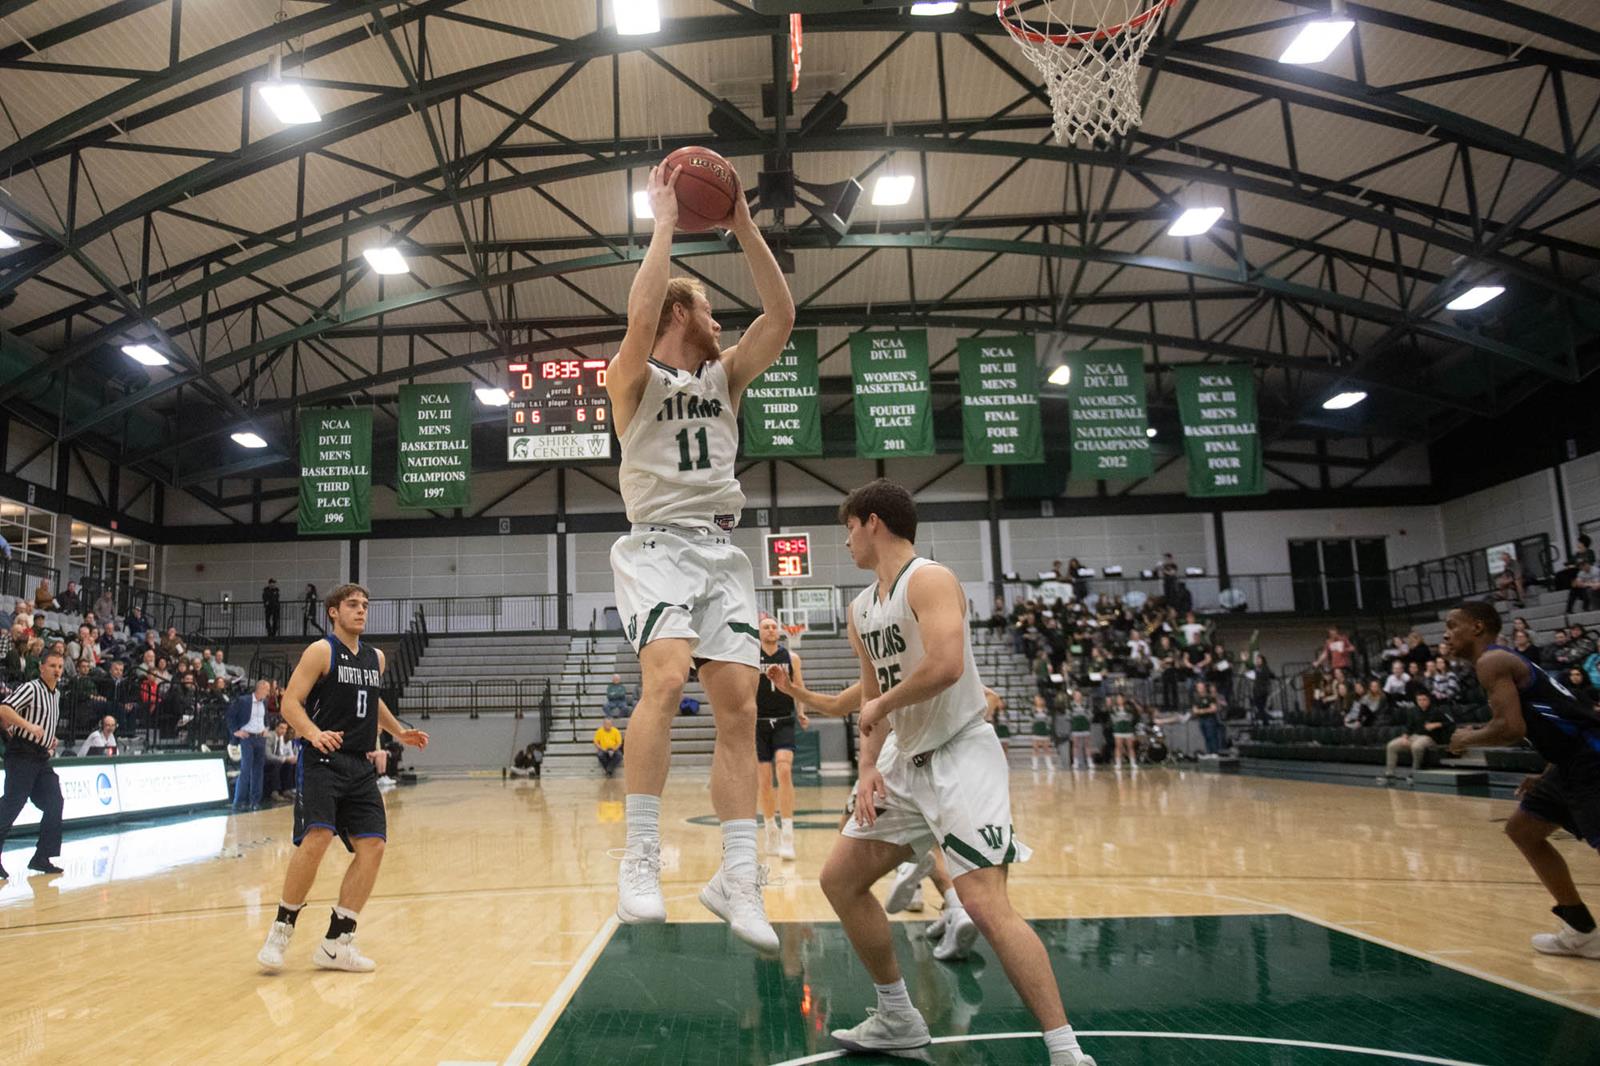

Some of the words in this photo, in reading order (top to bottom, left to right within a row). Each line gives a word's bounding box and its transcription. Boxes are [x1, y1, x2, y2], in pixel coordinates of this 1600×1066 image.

[872, 338, 904, 349] NCAA
[870, 350, 892, 360] DIV.
[894, 349, 907, 359] III
[981, 348, 1014, 358] NCAA
[785, 356, 798, 365] III
[980, 363, 1001, 373] DIV.
[1003, 362, 1016, 373] III
[1085, 363, 1124, 375] NCAA
[522, 373, 533, 390] 0
[542, 361, 580, 379] 19:35
[596, 369, 607, 387] 0
[764, 372, 797, 382] MEN'S
[863, 371, 917, 383] WOMEN'S
[1199, 376, 1232, 386] NCAA
[982, 379, 1016, 389] MEN'S
[1084, 376, 1112, 388] DIV.
[1114, 375, 1129, 387] III
[747, 386, 816, 398] BASKETBALL
[856, 382, 927, 395] BASKETBALL
[420, 395, 450, 404] NCAA
[965, 394, 1037, 406] BASKETBALL
[1078, 394, 1137, 406] WOMEN'S
[1222, 391, 1236, 402] III
[548, 399, 568, 407] player
[763, 403, 798, 413] THIRD
[417, 410, 437, 420] DIV.
[440, 409, 452, 419] III
[515, 410, 525, 424] 0
[531, 410, 540, 424] 6
[576, 408, 586, 422] 6
[596, 407, 605, 421] 0
[870, 404, 916, 416] FOURTH
[1072, 408, 1146, 420] BASKETBALL
[1200, 408, 1237, 419] MEN'S
[875, 416, 912, 427] PLACE
[985, 411, 1019, 421] FINAL
[321, 420, 351, 430] NCAA
[764, 419, 800, 429] PLACE
[1184, 423, 1257, 436] BASKETBALL
[418, 425, 451, 435] MEN'S
[987, 427, 1018, 438] FOUR
[1077, 426, 1144, 438] NATIONAL
[319, 435, 339, 445] DIV.
[340, 435, 352, 444] III
[539, 435, 579, 447] SHIRK
[772, 435, 794, 445] 2006
[884, 440, 905, 450] 2011
[1074, 438, 1149, 451] CHAMPIONS
[401, 440, 468, 452] BASKETBALL
[675, 426, 712, 472] 11
[992, 443, 1015, 454] 2012
[1204, 441, 1240, 452] FINAL
[319, 451, 351, 461] MEN'S
[532, 446, 585, 458] CENTER
[407, 456, 461, 467] NATIONAL
[1098, 456, 1127, 468] 2012
[1208, 457, 1240, 469] FOUR
[301, 465, 369, 477] BASKETBALL
[402, 471, 466, 483] CHAMPIONS
[316, 482, 350, 492] THIRD
[424, 488, 444, 498] 1997
[317, 498, 351, 508] PLACE
[324, 513, 344, 523] 1996
[773, 539, 807, 554] 19:35
[778, 556, 801, 575] 30
[861, 623, 907, 660] TITANS
[338, 665, 363, 686] NORTH
[356, 690, 368, 718] 0
